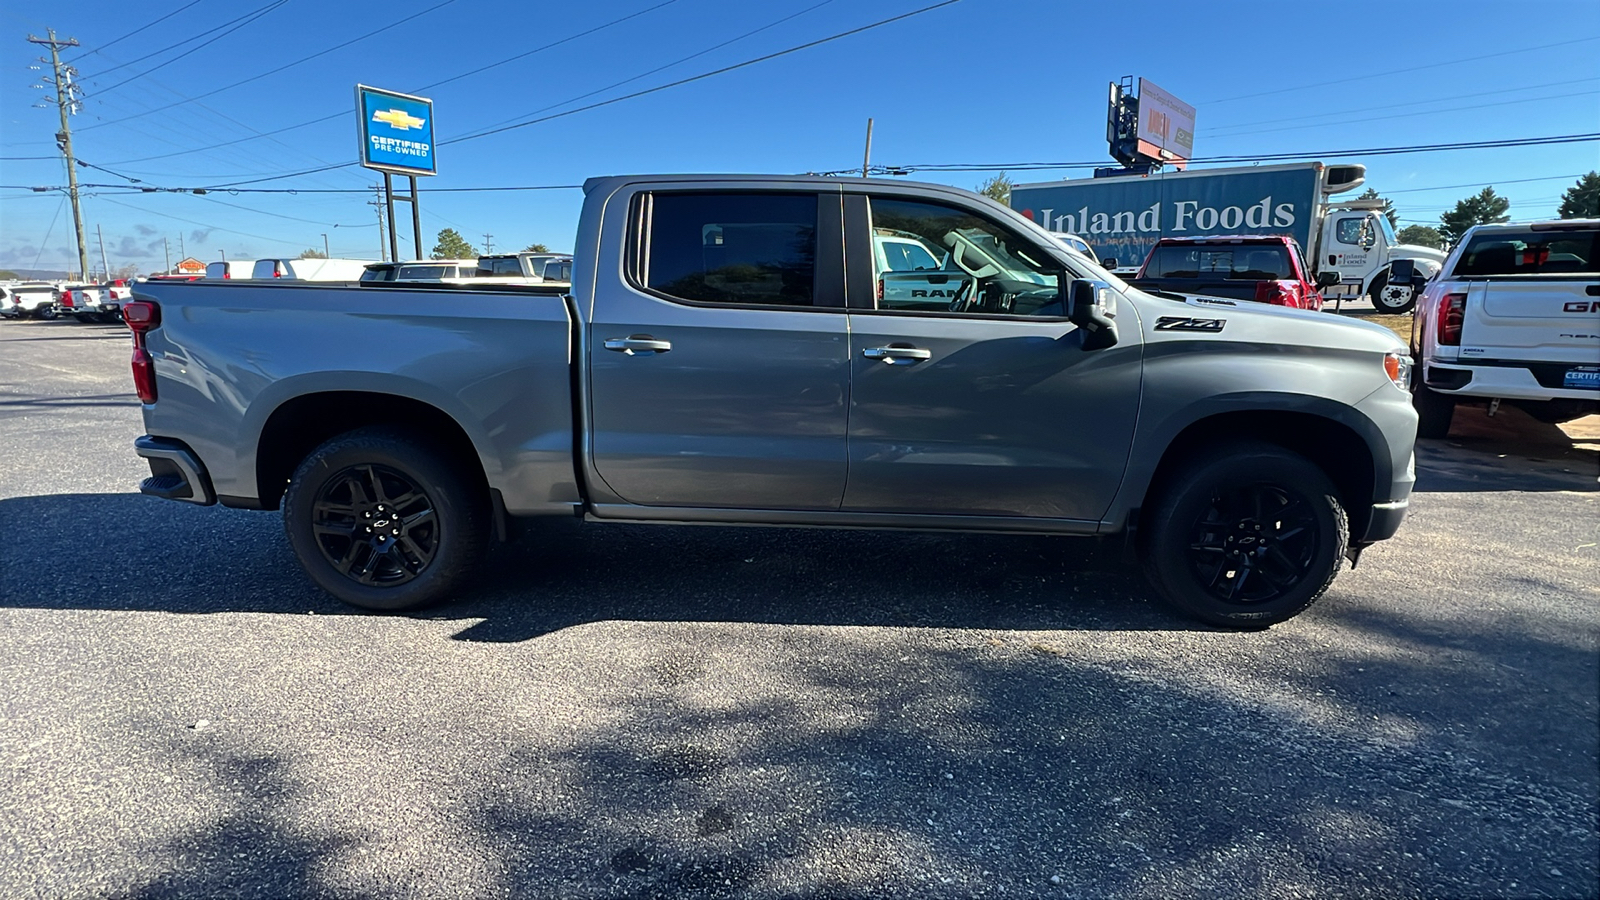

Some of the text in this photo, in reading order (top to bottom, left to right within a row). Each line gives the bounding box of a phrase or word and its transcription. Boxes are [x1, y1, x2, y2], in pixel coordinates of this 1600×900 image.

[371, 135, 430, 151] CERTIFIED
[374, 143, 428, 157] PRE-OWNED
[1041, 195, 1296, 234] Inland Foods
[1153, 316, 1228, 333] Z71
[1565, 371, 1600, 380] CERTIF
